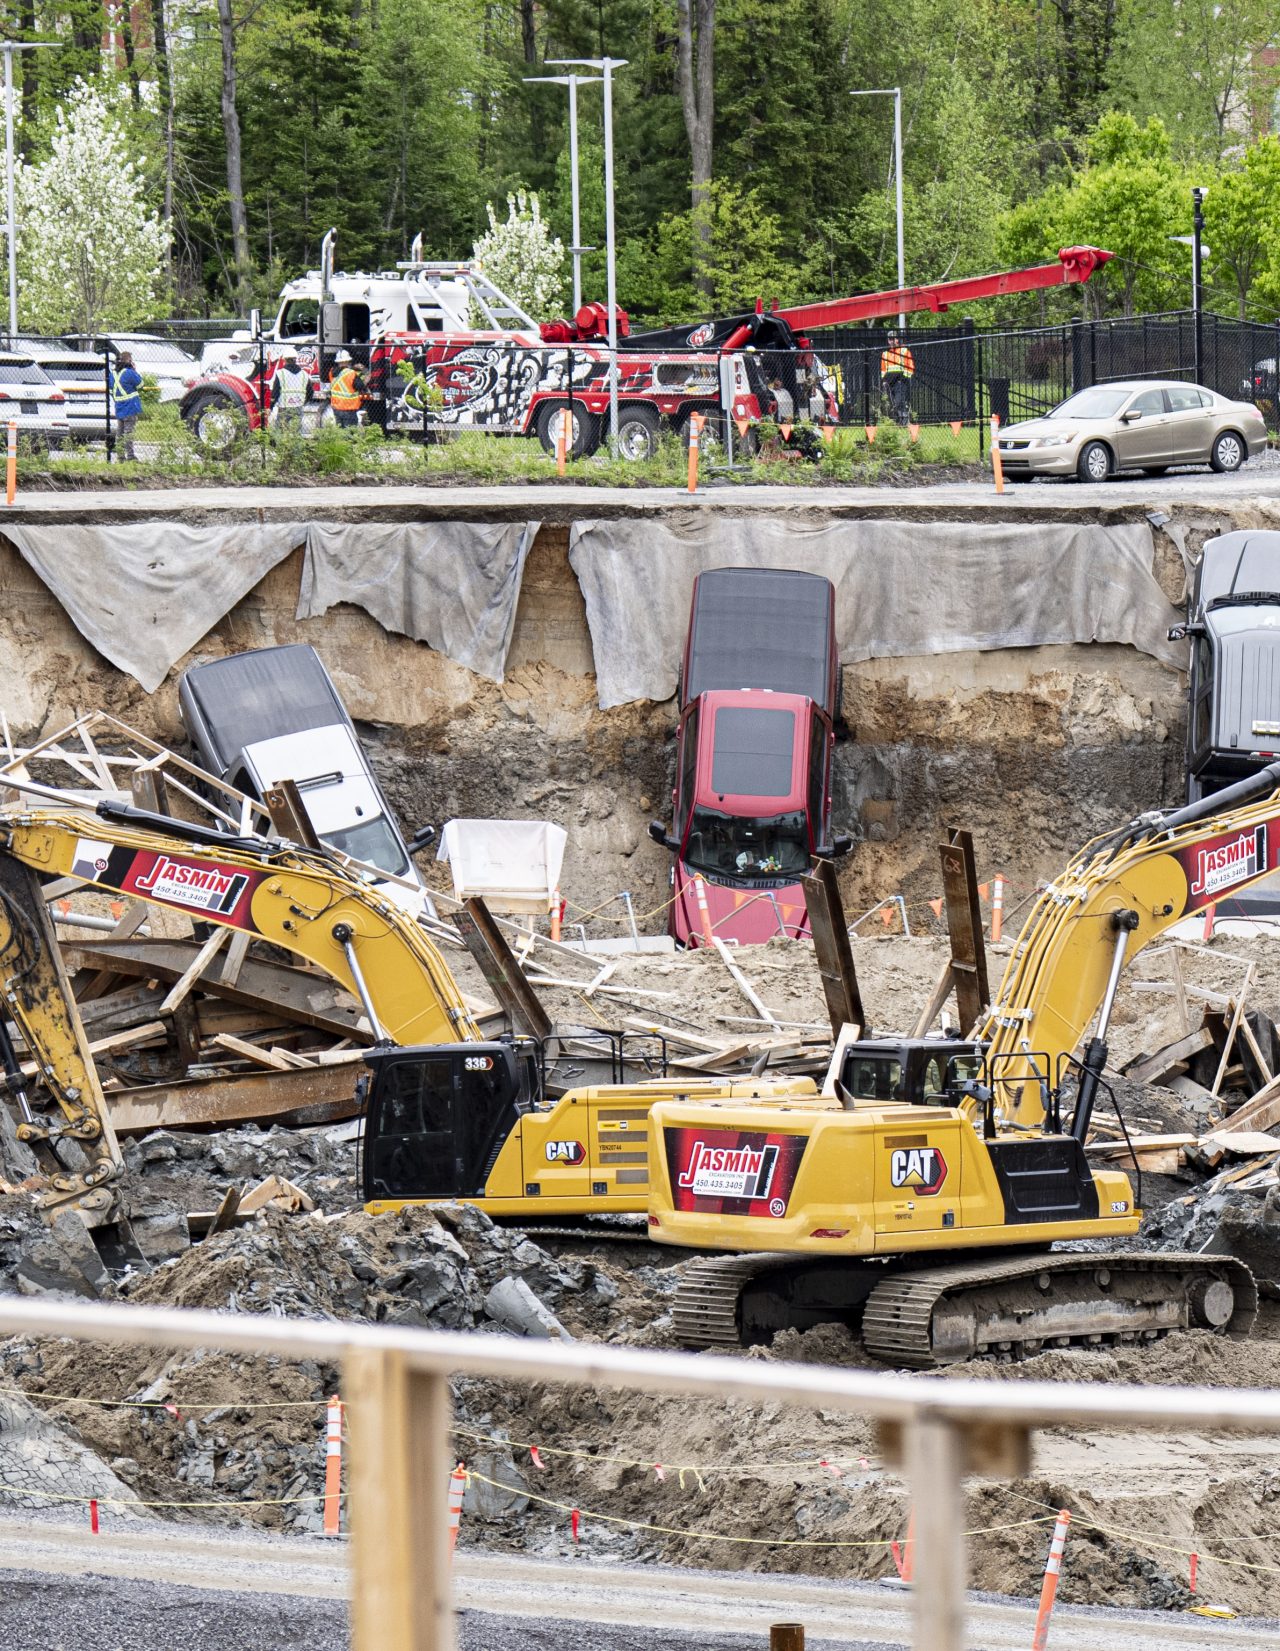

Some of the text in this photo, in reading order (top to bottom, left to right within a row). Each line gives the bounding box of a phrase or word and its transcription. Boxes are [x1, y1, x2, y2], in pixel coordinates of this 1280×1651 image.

[95, 860, 106, 869] 50
[944, 854, 961, 874] 68
[155, 884, 208, 903] 450.435.3405
[464, 1056, 487, 1071] 336
[545, 1141, 577, 1161] CAT
[891, 1149, 935, 1187] CAT
[695, 1179, 744, 1190] 450.435.3405
[773, 1202, 782, 1213] 50
[1111, 1201, 1126, 1213] 336
